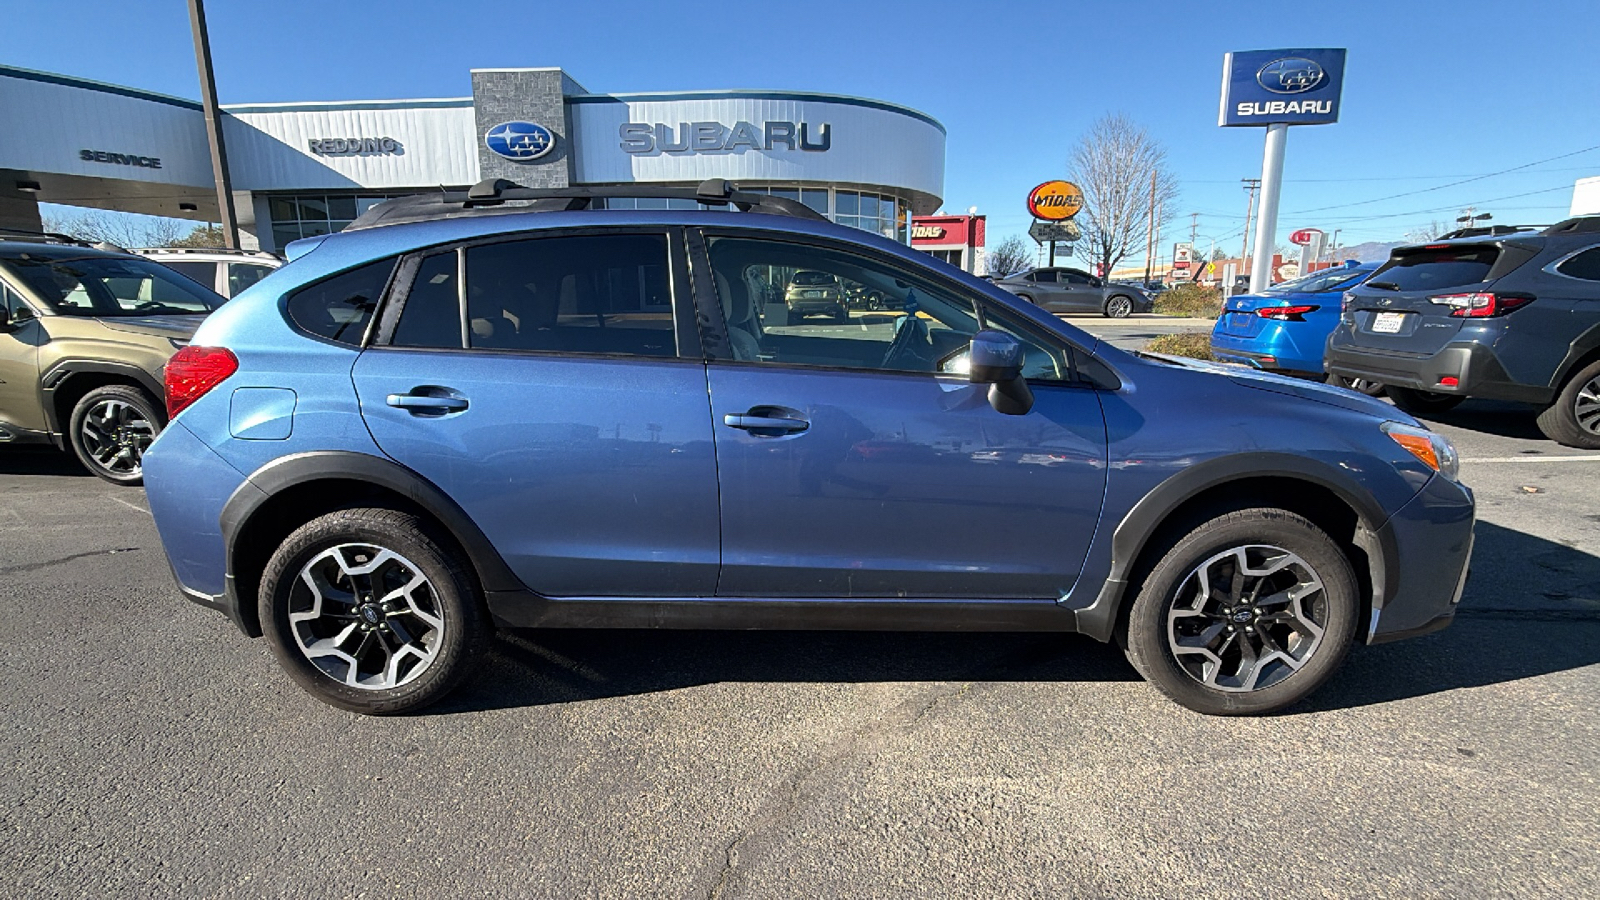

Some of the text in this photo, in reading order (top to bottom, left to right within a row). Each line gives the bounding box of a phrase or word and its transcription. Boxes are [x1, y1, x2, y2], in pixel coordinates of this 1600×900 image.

[1237, 100, 1332, 116] SUBARU
[308, 136, 396, 154] REDDING
[619, 120, 831, 153] SUBARU
[79, 148, 162, 170] SERVICE
[1034, 194, 1082, 207] MIDAS
[911, 226, 942, 238] IDAS
